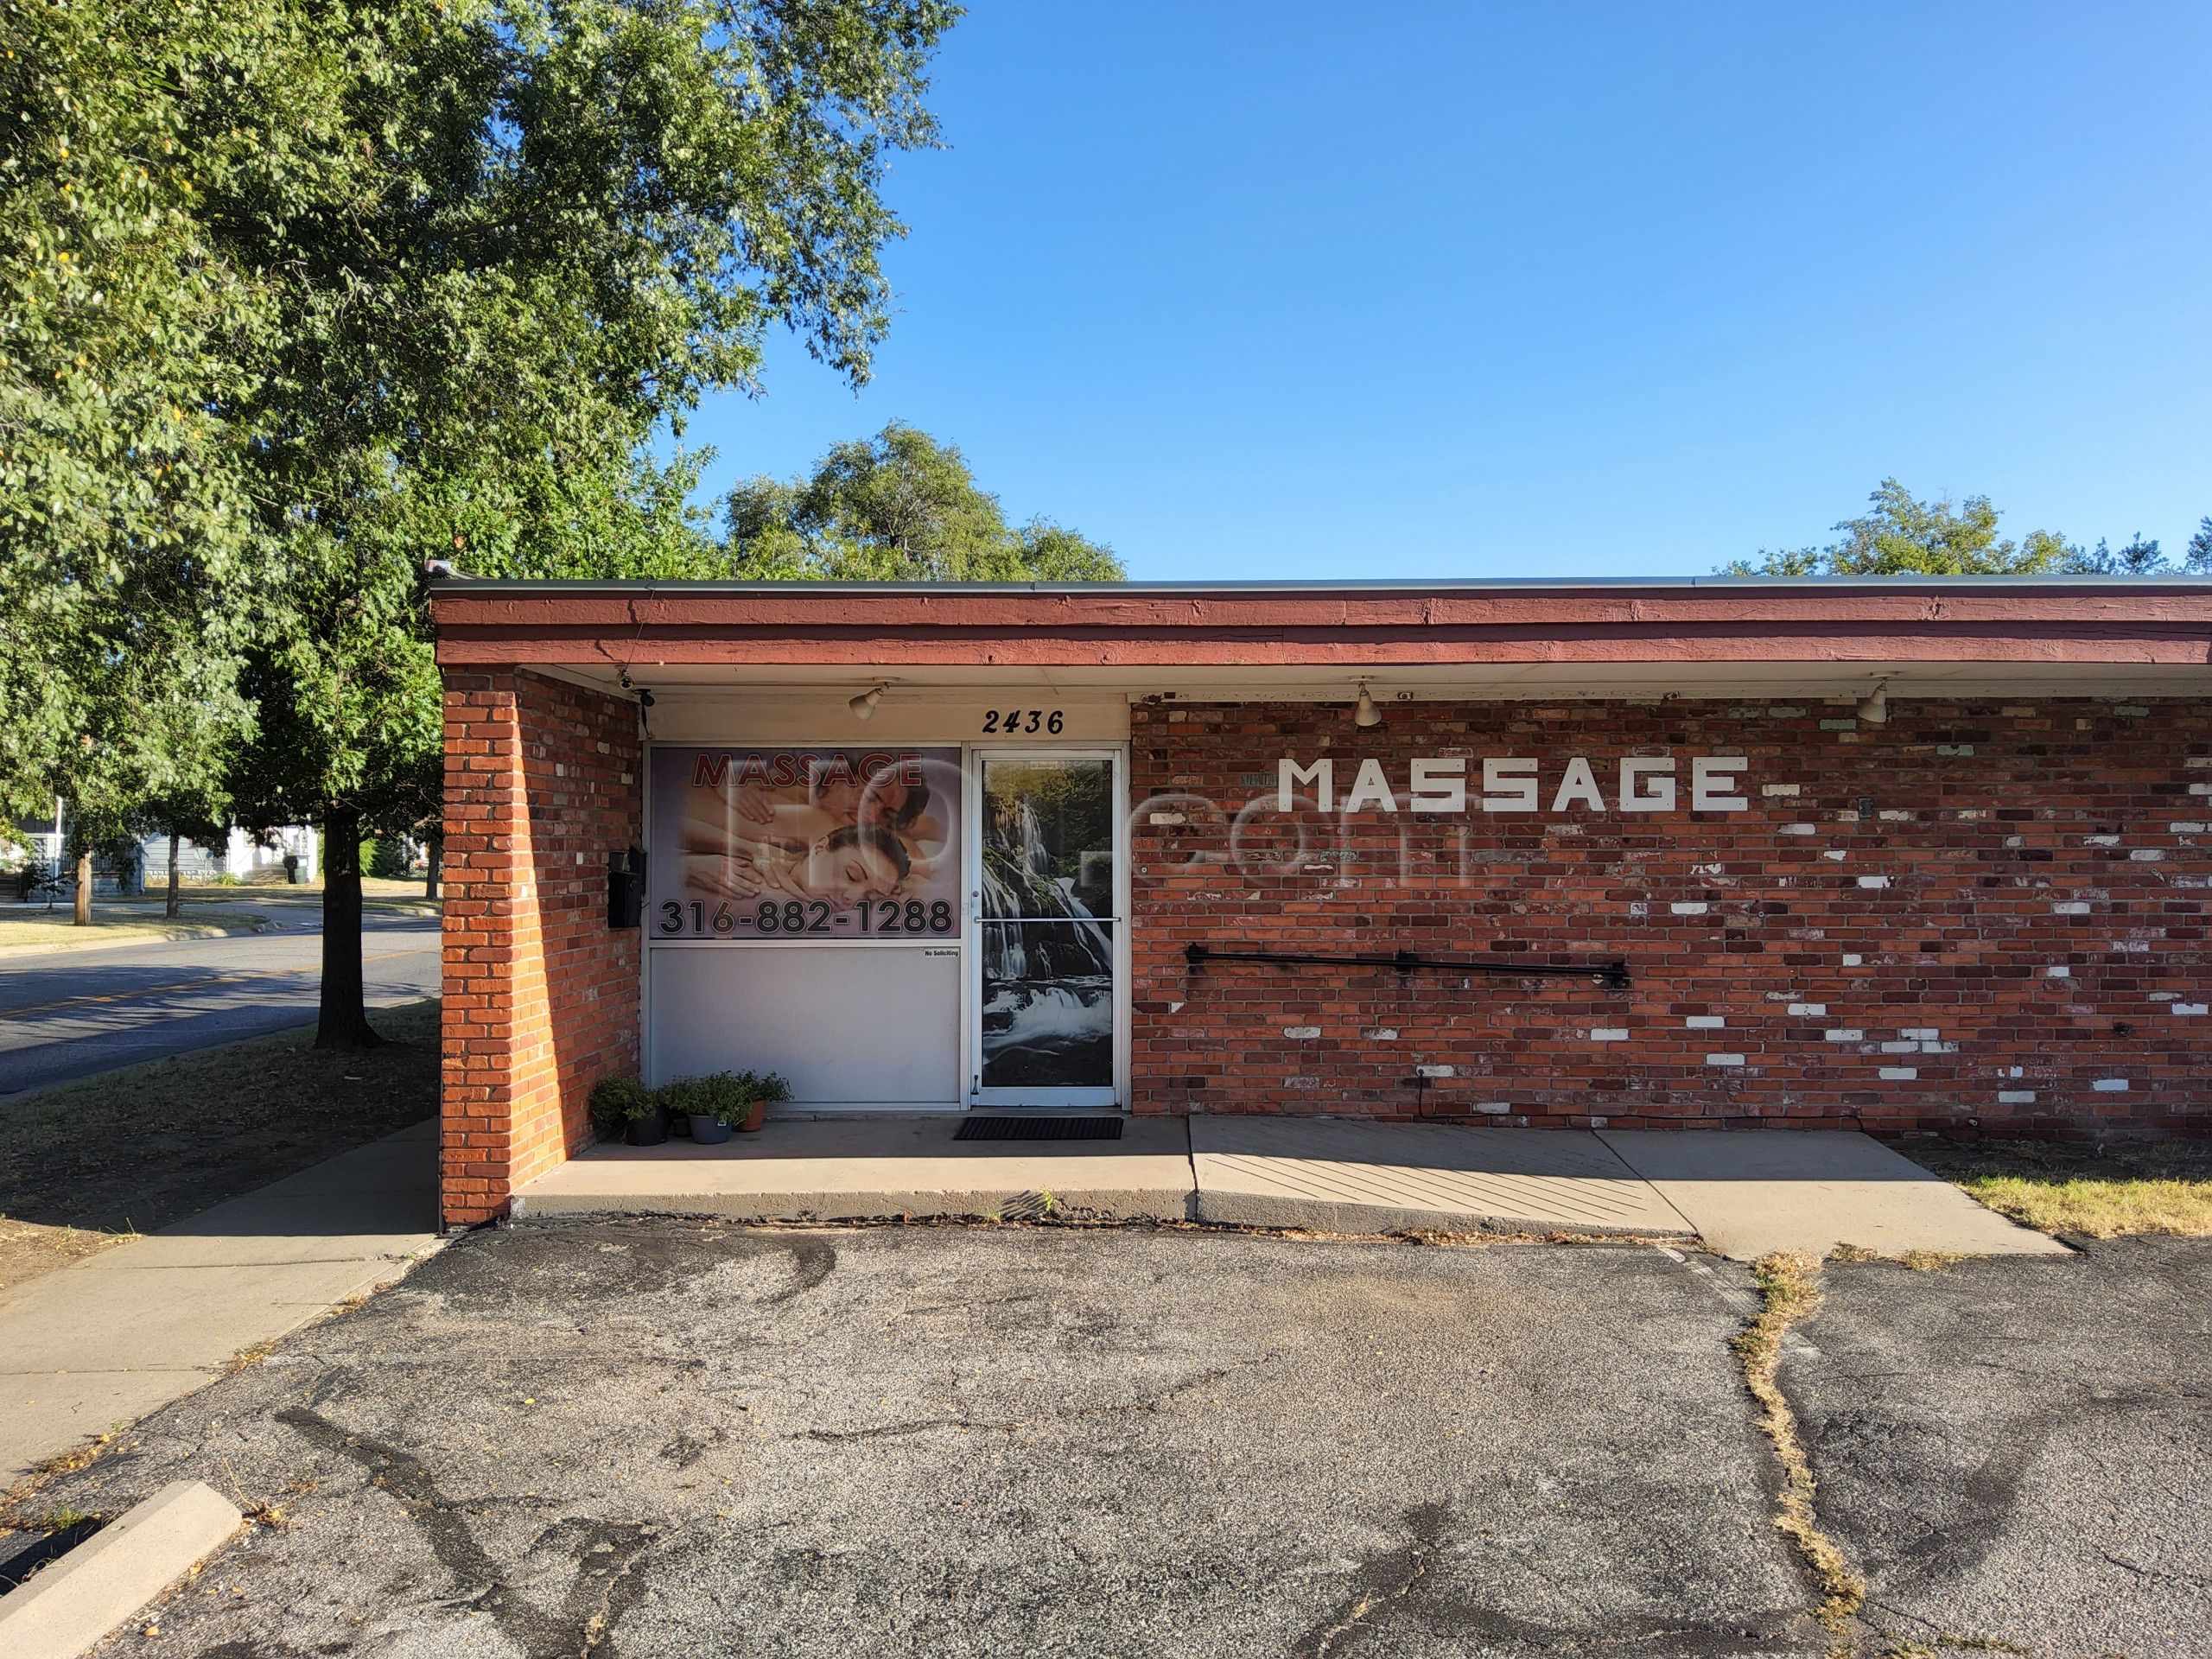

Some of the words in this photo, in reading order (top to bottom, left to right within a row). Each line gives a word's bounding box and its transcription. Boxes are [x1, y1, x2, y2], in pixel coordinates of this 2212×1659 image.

[982, 709, 1065, 734] 2436
[692, 753, 923, 787] MASSAGE
[1278, 757, 1748, 812] MASSAGE
[658, 899, 954, 934] 316-882-1288
